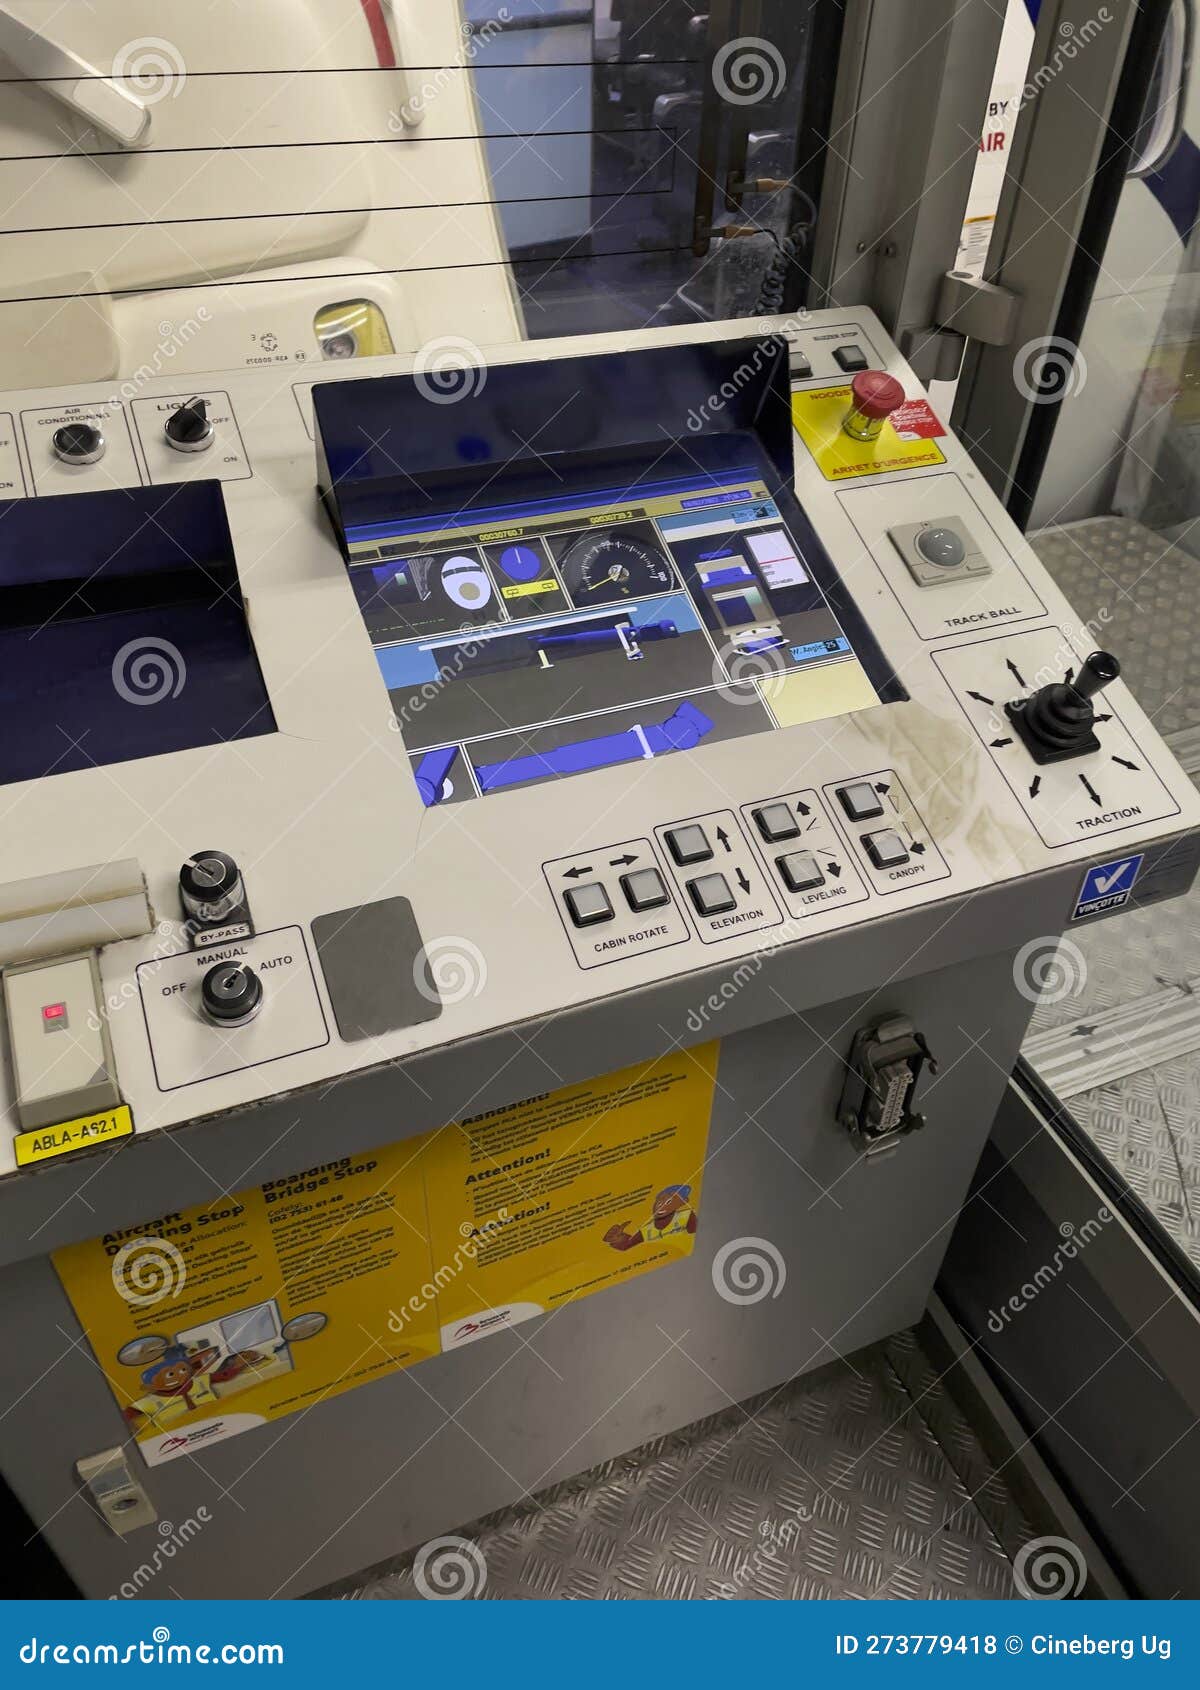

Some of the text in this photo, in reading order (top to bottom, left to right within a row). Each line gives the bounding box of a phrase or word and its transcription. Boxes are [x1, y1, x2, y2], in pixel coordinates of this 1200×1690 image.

[989, 100, 1009, 117] BY
[809, 388, 850, 401] NOODS
[64, 407, 81, 415] AIR
[156, 399, 212, 412] LIGS
[211, 416, 230, 425] OFF
[223, 454, 238, 463] ON
[832, 452, 938, 476] ARRET D'URGENCE
[943, 606, 1023, 628] TRACK BALL
[1075, 805, 1142, 831] TRACTION
[888, 863, 926, 881] CANOPY
[801, 886, 848, 905] LEVELING
[710, 908, 765, 931] ELEVATION
[200, 926, 246, 943] BY-PASS
[593, 924, 669, 953] CABIN ROTATE
[196, 947, 249, 966] MANUAL
[259, 955, 293, 971] AUTO
[161, 982, 188, 997] OFF
[261, 1156, 352, 1193] Boarding
[464, 1147, 551, 1186] Attention!
[264, 1158, 378, 1204] Bridge Stop
[196, 1204, 246, 1227] Stop
[101, 1211, 184, 1246] Aircraft
